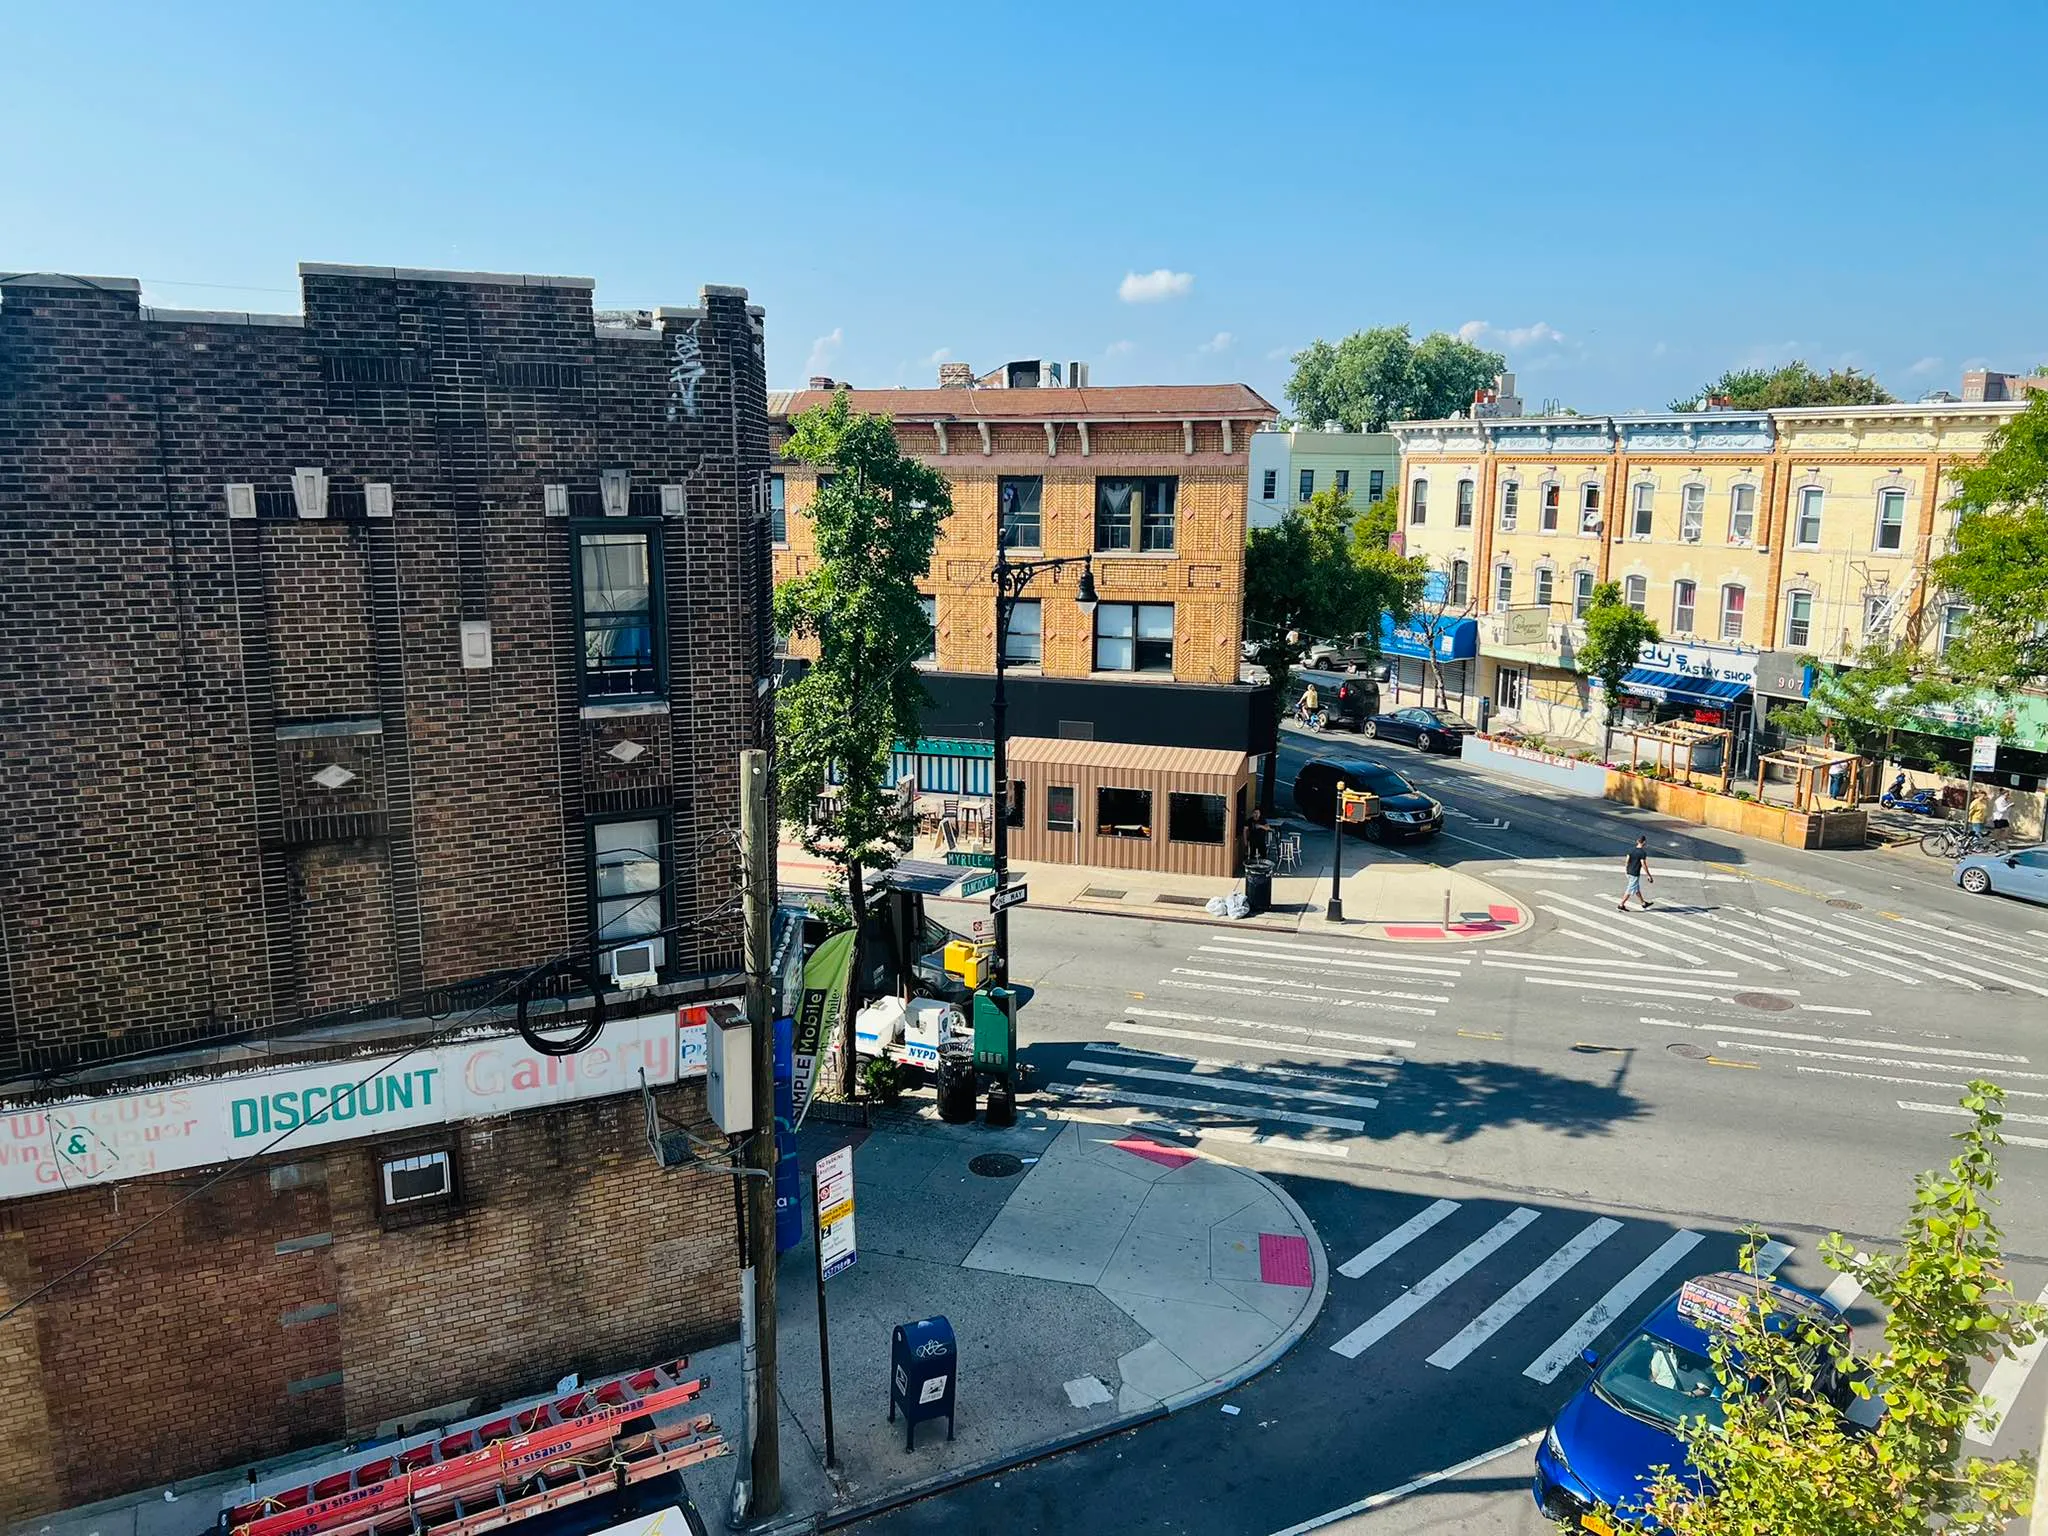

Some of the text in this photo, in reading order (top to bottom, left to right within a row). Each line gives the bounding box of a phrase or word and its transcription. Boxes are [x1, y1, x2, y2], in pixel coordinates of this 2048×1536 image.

[1641, 645, 1688, 668] dy's
[1679, 663, 1752, 683] PASTRY SHOP
[1777, 676, 1804, 690] 907
[947, 853, 983, 867] MYRTLE
[963, 877, 989, 897] HANCOCK
[995, 890, 1025, 907] ONE WAY
[792, 992, 823, 1122] SIMPLE Mobile
[908, 1046, 937, 1062] NYPD
[464, 1036, 670, 1097] Gallery
[232, 1067, 439, 1139] DISCOUNT
[67, 1134, 87, 1155] &
[34, 1150, 156, 1185] Gallery
